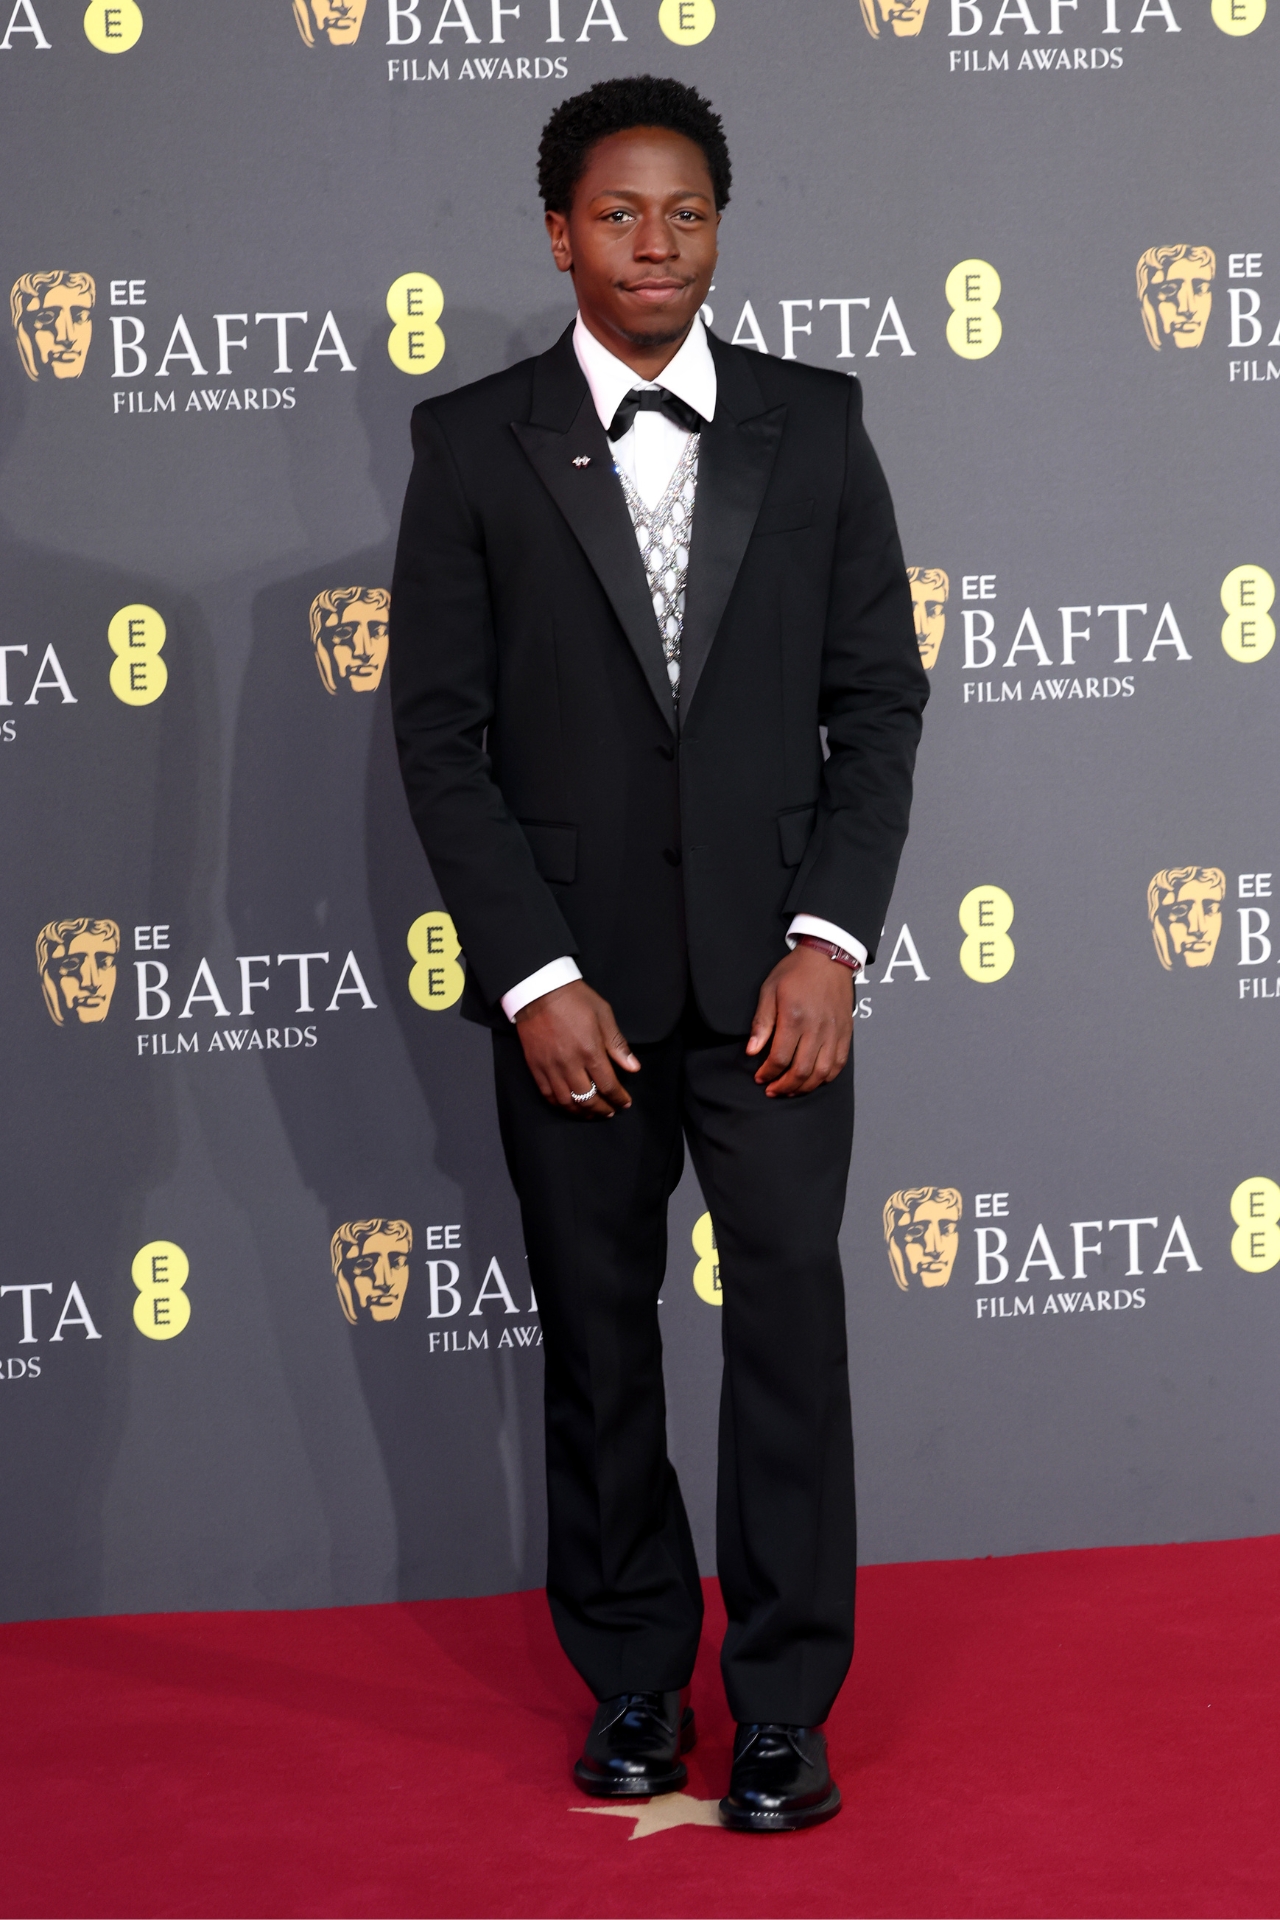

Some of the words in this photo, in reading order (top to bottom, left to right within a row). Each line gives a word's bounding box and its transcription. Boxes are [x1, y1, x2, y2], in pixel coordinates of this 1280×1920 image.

[105, 9, 122, 37] E
[679, 3, 695, 30] E
[388, 59, 449, 80] FILM
[459, 57, 567, 79] AWARDS
[950, 50, 1008, 71] FILM
[1018, 48, 1123, 70] AWARDS
[1229, 253, 1262, 277] EE
[110, 280, 146, 305] EE
[966, 275, 981, 301] E
[407, 289, 423, 316] E
[704, 296, 917, 360] AFTA
[967, 317, 982, 344] E
[1228, 289, 1280, 347] B
[109, 311, 356, 377] BAFTA
[408, 332, 425, 359] E
[114, 391, 175, 413] FILM
[185, 388, 295, 411] AWARDS
[963, 575, 996, 599] EE
[1240, 580, 1255, 606] E
[129, 620, 145, 647] E
[961, 602, 1192, 668] BAFTA
[1241, 622, 1256, 647] E
[130, 663, 147, 690] E
[964, 681, 1022, 702] FILM
[1031, 676, 1134, 700] AWARDS
[1239, 874, 1271, 897] EE
[979, 900, 994, 926] E
[135, 925, 170, 950] EE
[427, 926, 444, 953] E
[1237, 908, 1280, 965] B
[980, 942, 995, 968] E
[134, 950, 378, 1020] BAFTA
[428, 969, 445, 995] E
[1240, 978, 1280, 998] FIL
[138, 1033, 198, 1055] FILM
[208, 1027, 317, 1051] AWARDS
[976, 1193, 1009, 1217] EE
[1250, 1192, 1264, 1217] E
[427, 1225, 461, 1249] EE
[1251, 1232, 1265, 1258] E
[974, 1215, 1203, 1286] BAFTA
[152, 1256, 169, 1283] E
[426, 1256, 537, 1318] BA
[1, 1281, 102, 1343] TA
[154, 1298, 170, 1325] E
[977, 1296, 1034, 1318] FILM
[1043, 1288, 1145, 1314] AWARDS
[429, 1330, 488, 1352] FILM
